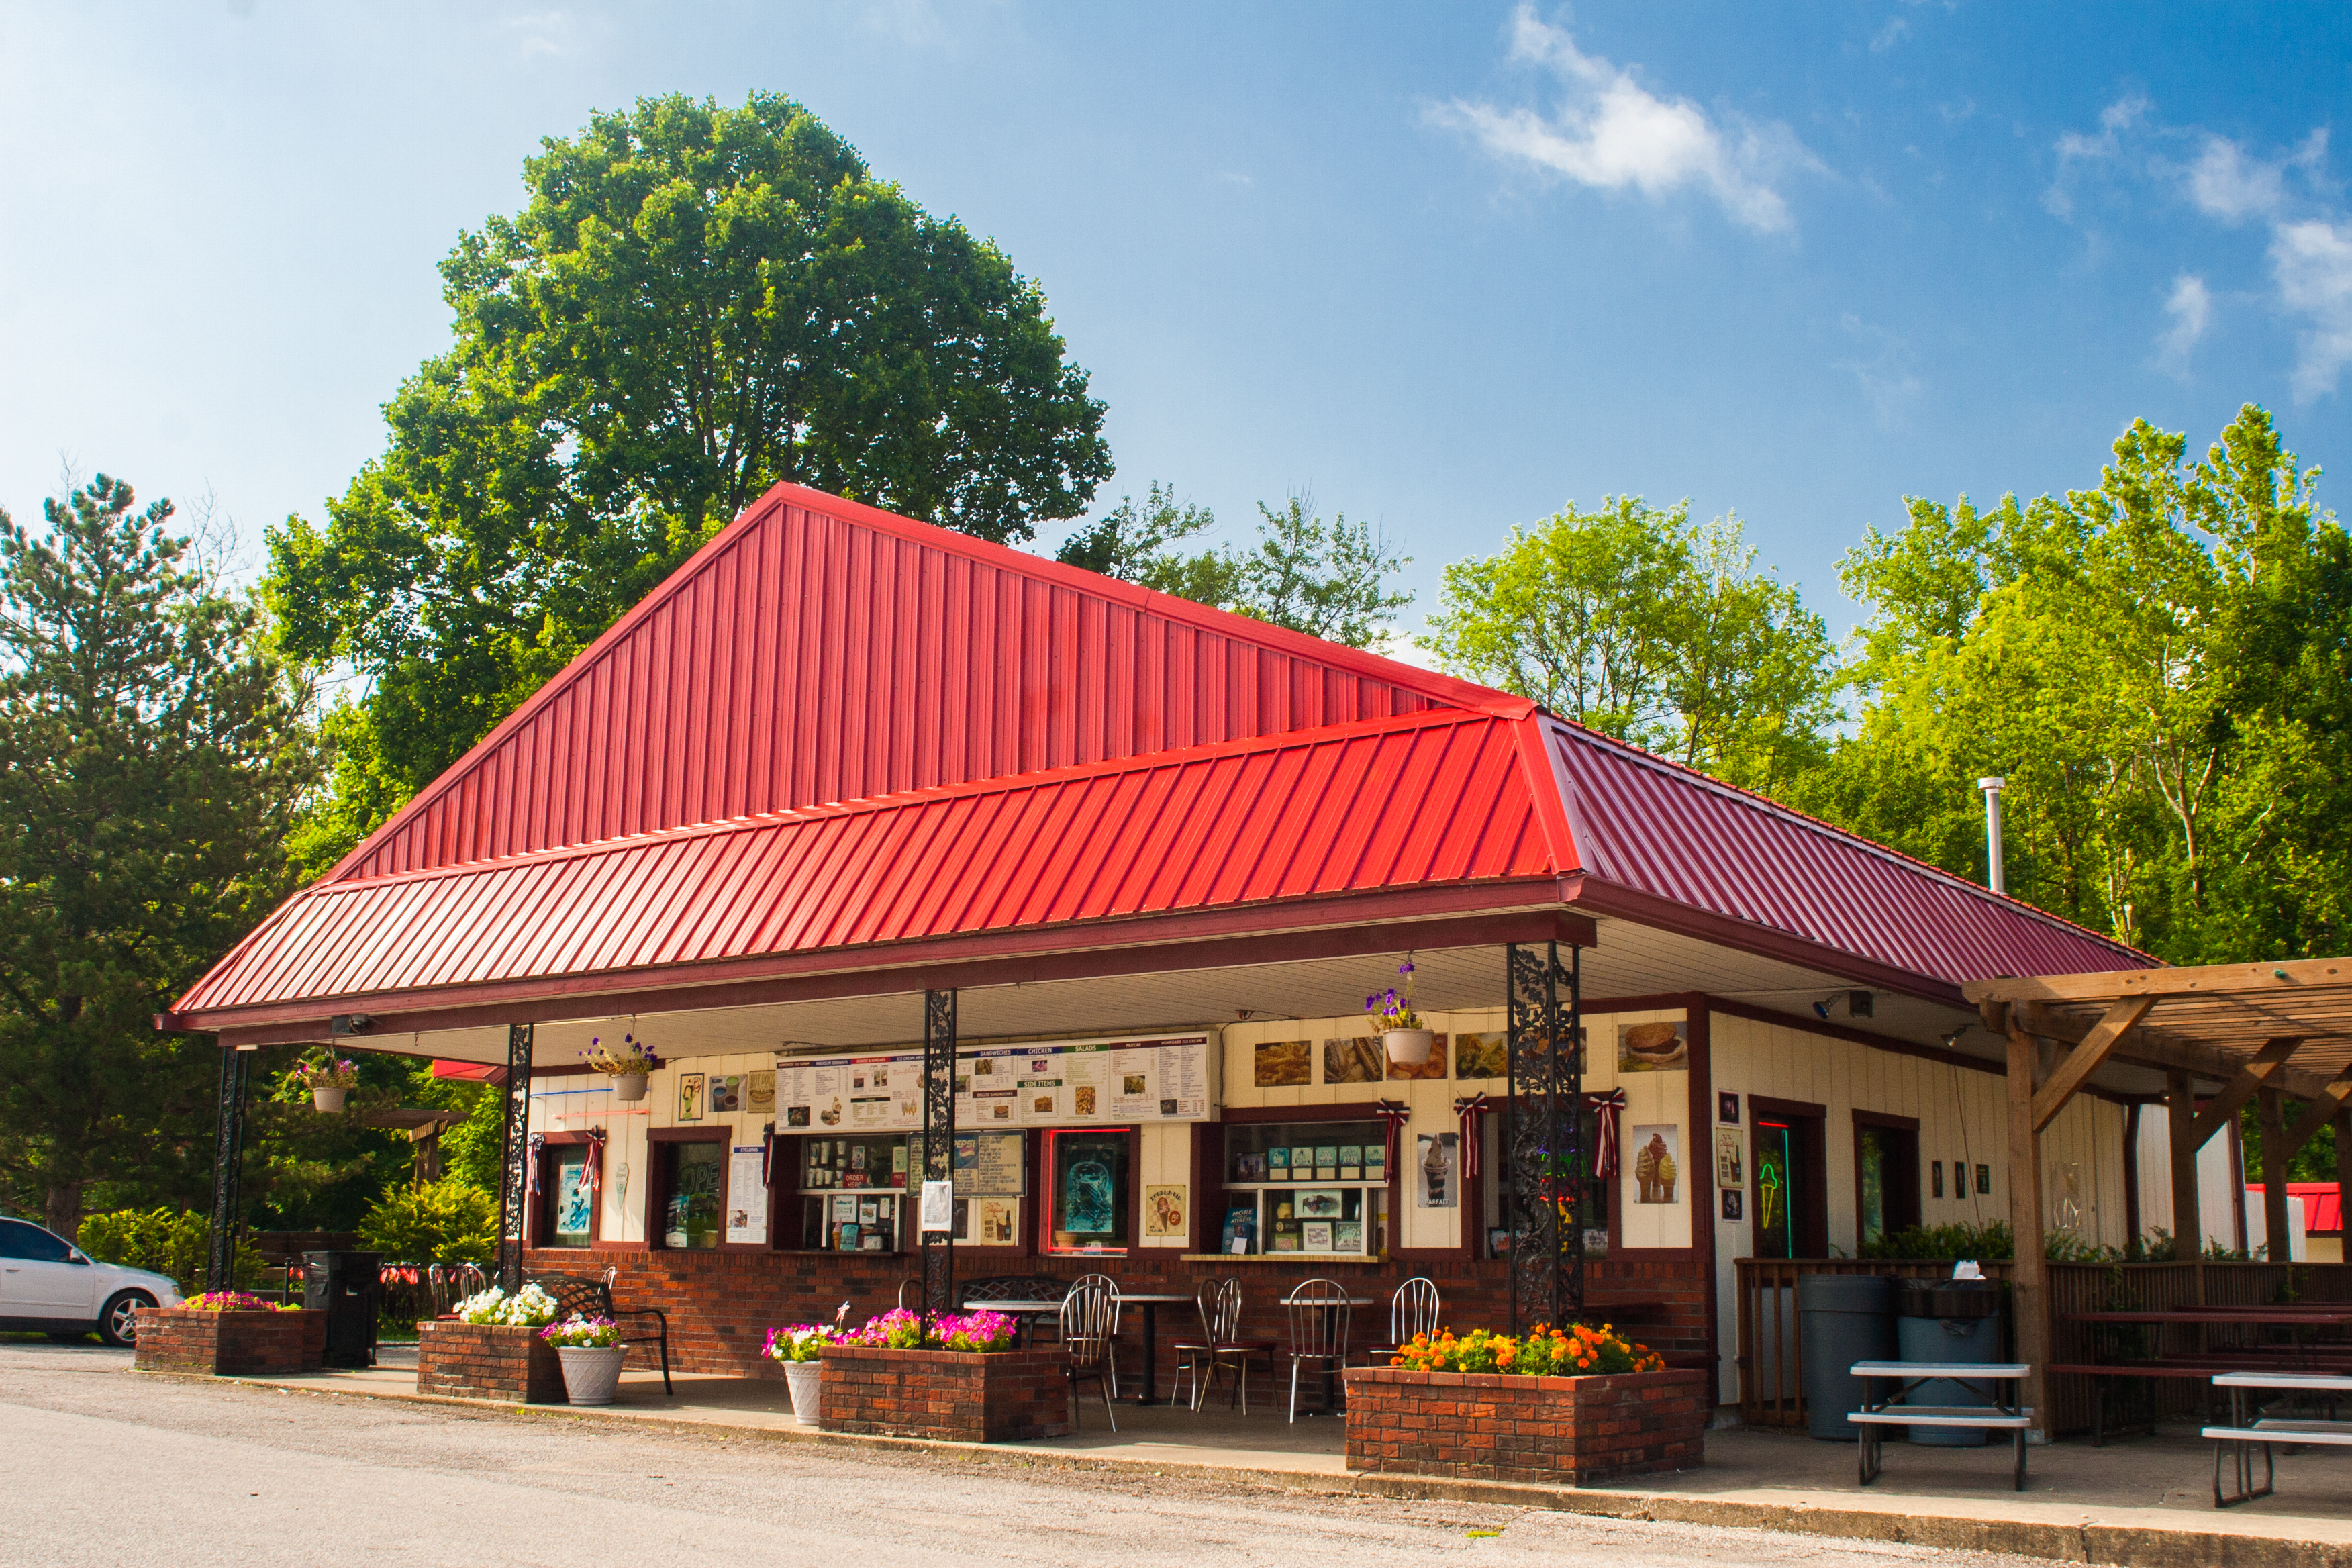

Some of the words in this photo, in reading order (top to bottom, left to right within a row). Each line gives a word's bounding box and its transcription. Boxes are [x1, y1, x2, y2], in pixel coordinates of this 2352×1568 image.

[750, 1074, 761, 1087] HOT
[761, 1073, 775, 1087] DOGS
[682, 1163, 720, 1195] OPE
[984, 1206, 1004, 1215] Original
